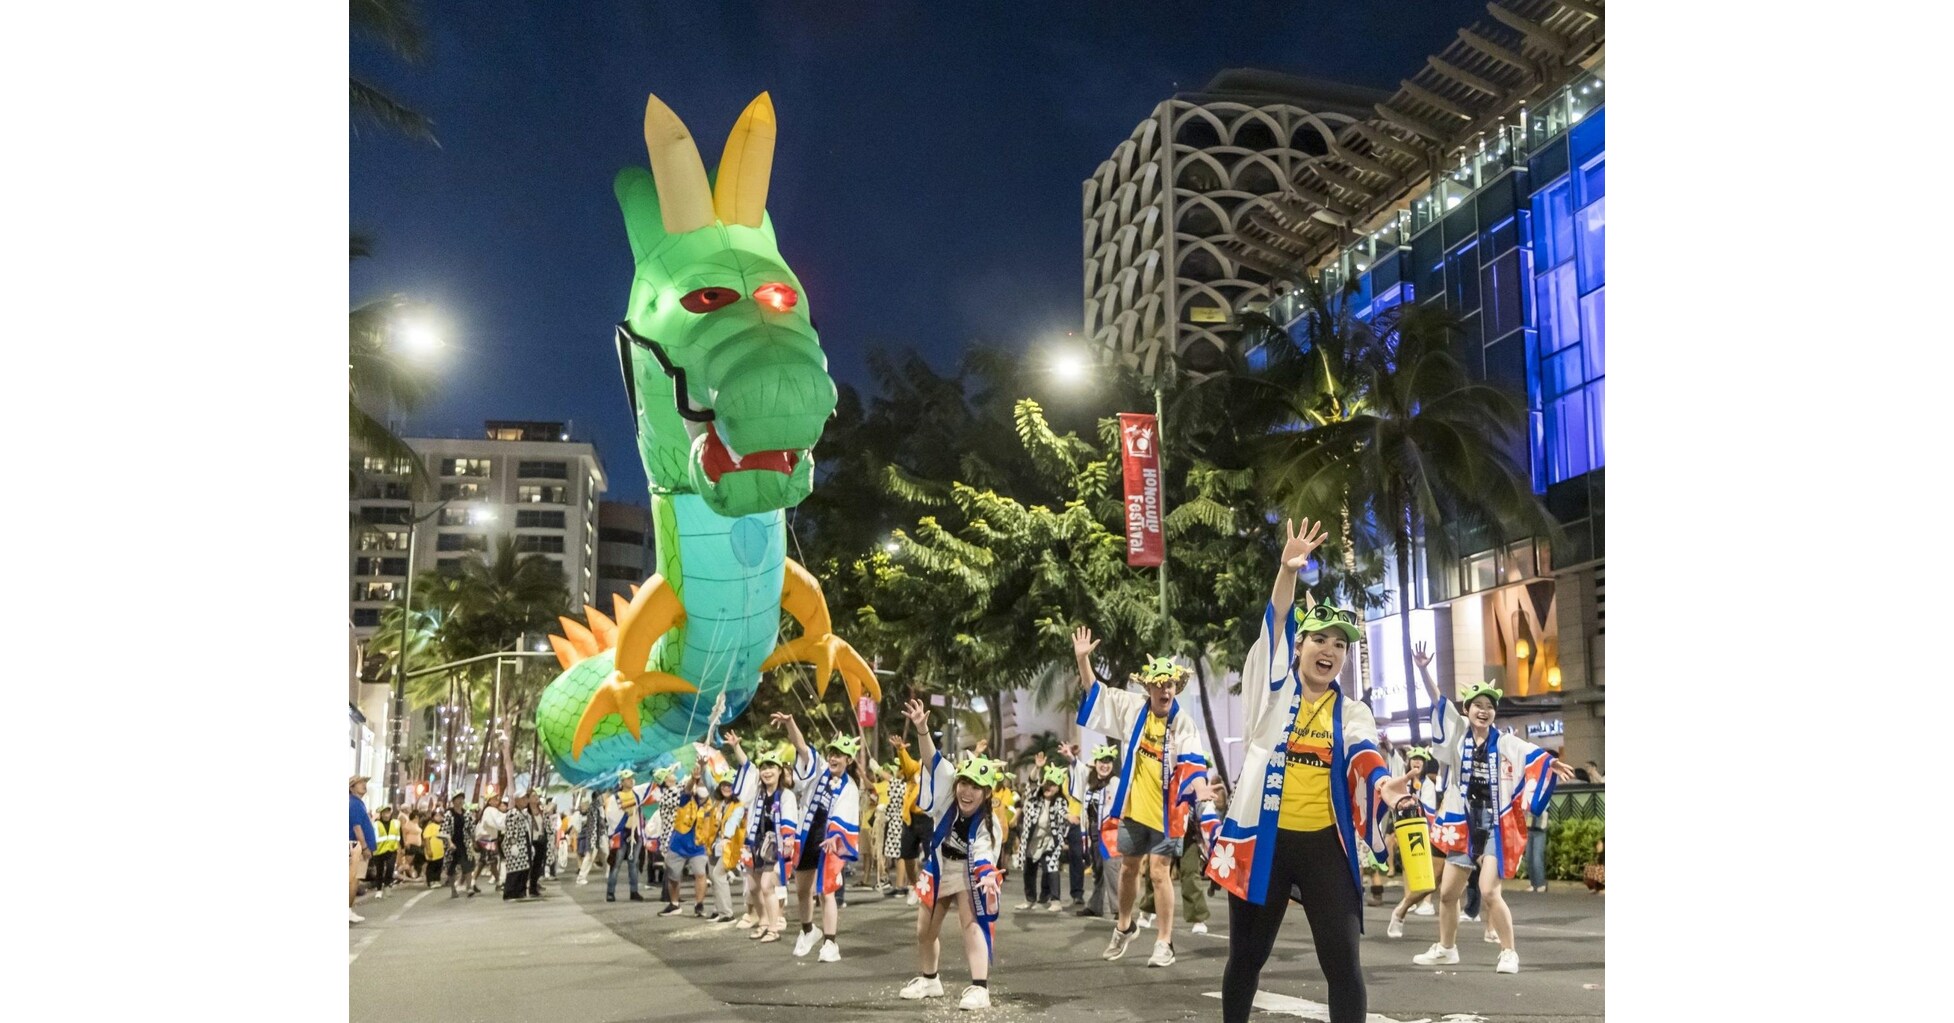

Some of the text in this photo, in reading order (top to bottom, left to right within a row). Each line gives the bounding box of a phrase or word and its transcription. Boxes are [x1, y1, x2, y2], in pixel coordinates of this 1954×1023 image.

[1143, 468, 1159, 533] HONOLULU
[1488, 751, 1500, 826] Pacific Harmony
